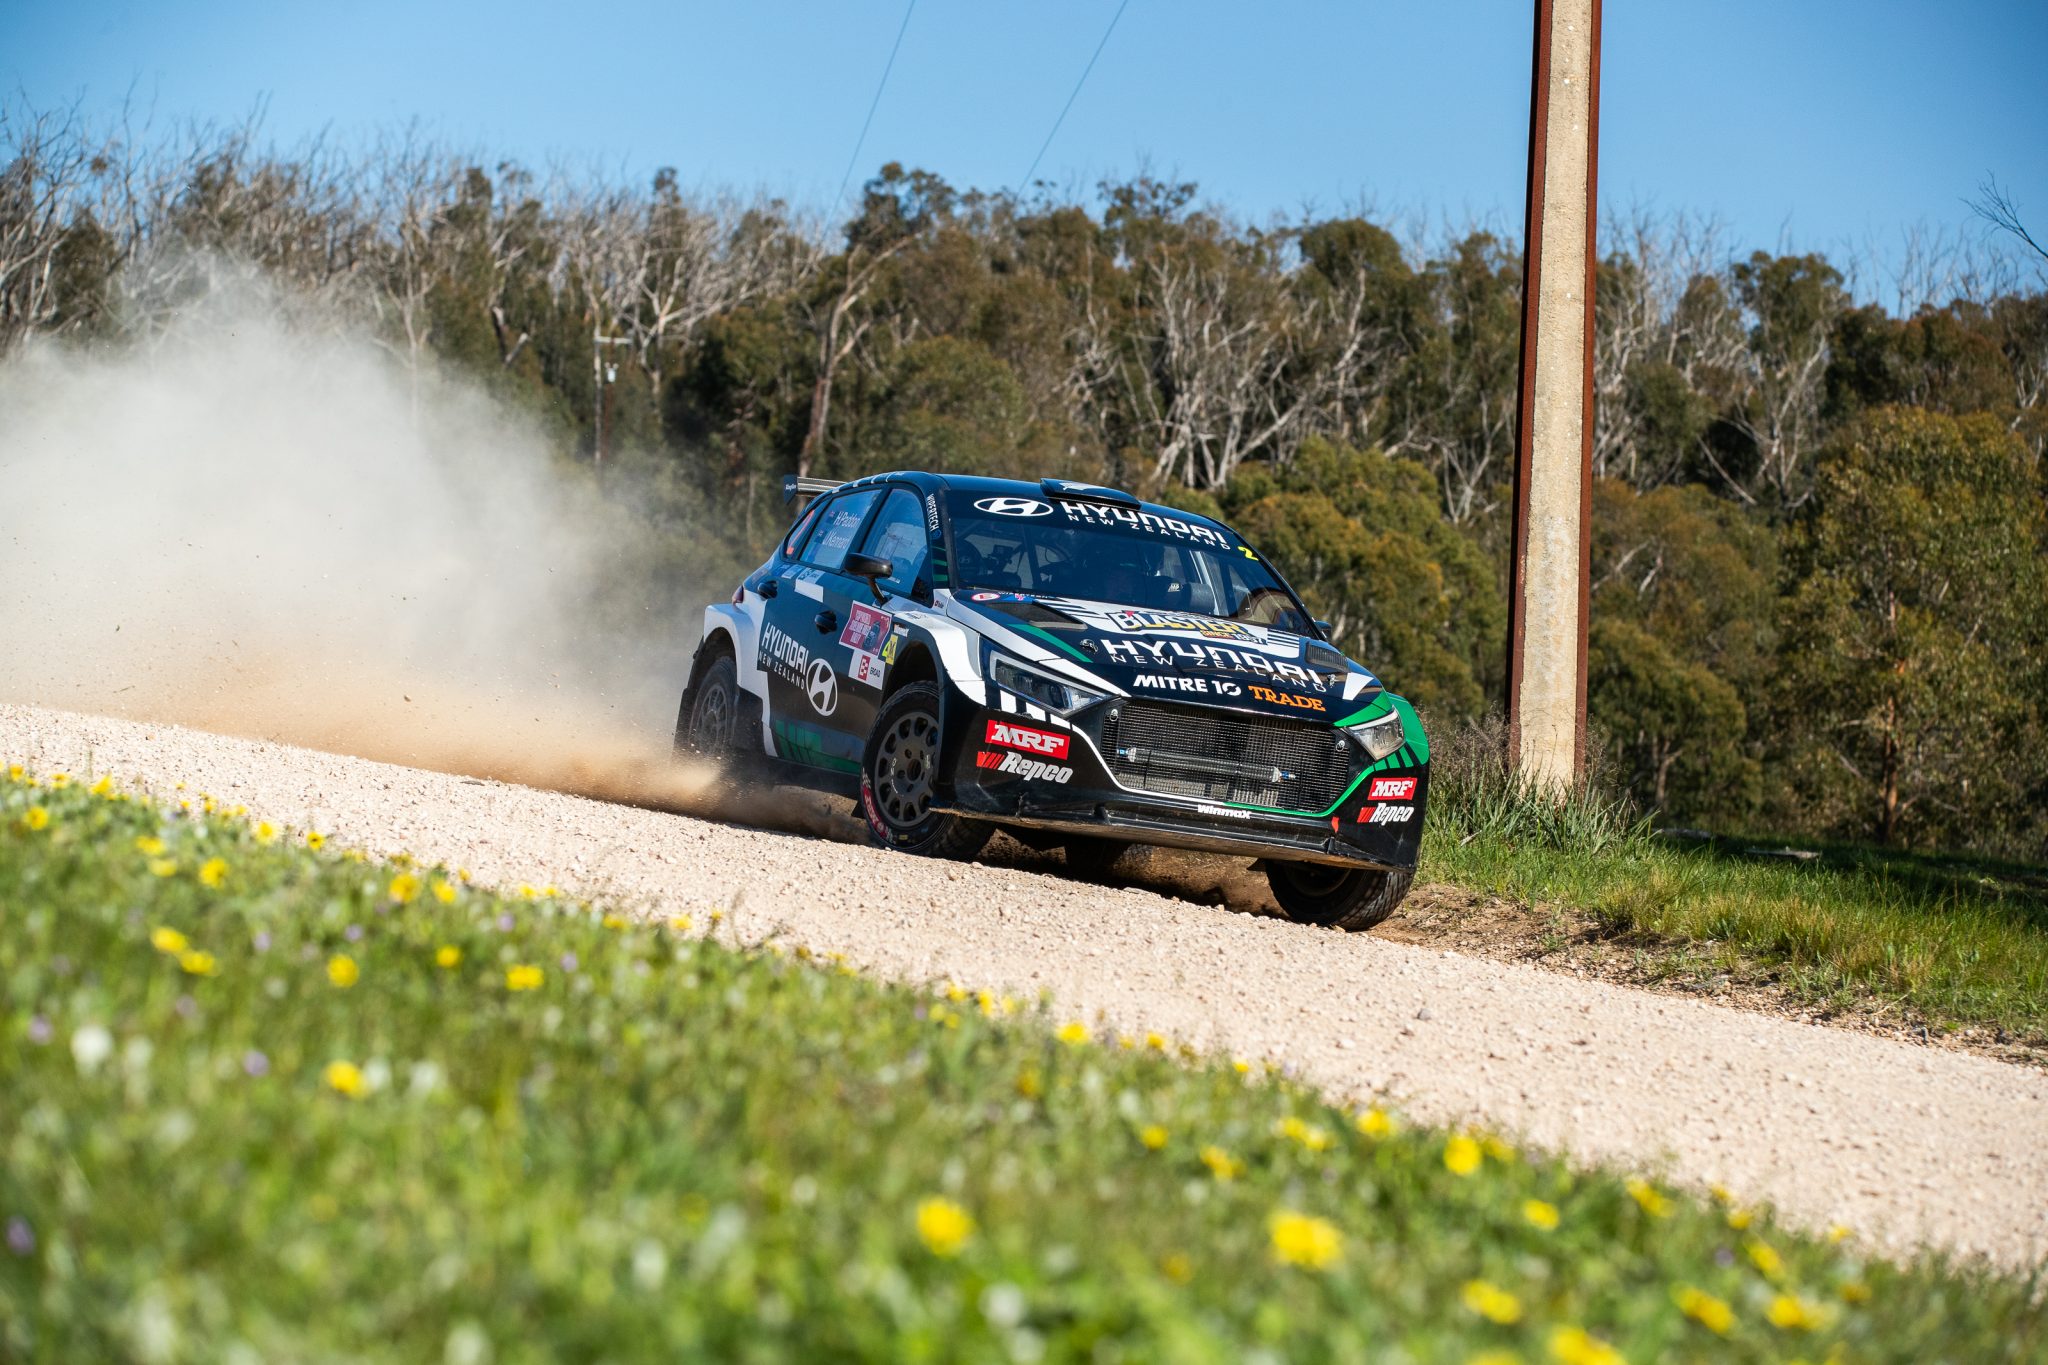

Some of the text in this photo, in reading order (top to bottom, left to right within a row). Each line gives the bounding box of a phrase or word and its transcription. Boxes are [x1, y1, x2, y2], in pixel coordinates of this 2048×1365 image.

[1060, 501, 1227, 544] HYUNDAI
[1067, 514, 1231, 550] NEW ZEALAND
[1238, 545, 1259, 561] 2
[1106, 610, 1250, 635] BLASTER
[761, 622, 809, 676] HYUNDAI
[1101, 639, 1322, 685] HYUNDAI
[758, 652, 805, 690] NEW ZEALAND
[1110, 653, 1328, 692] NEW ZEALAND
[1133, 675, 1242, 697] MITRE 10
[1248, 686, 1326, 712] TRADE
[991, 724, 1065, 753] MRF
[997, 751, 1074, 784] Repco
[1371, 780, 1413, 797] MRF
[1369, 803, 1415, 826] Repco
